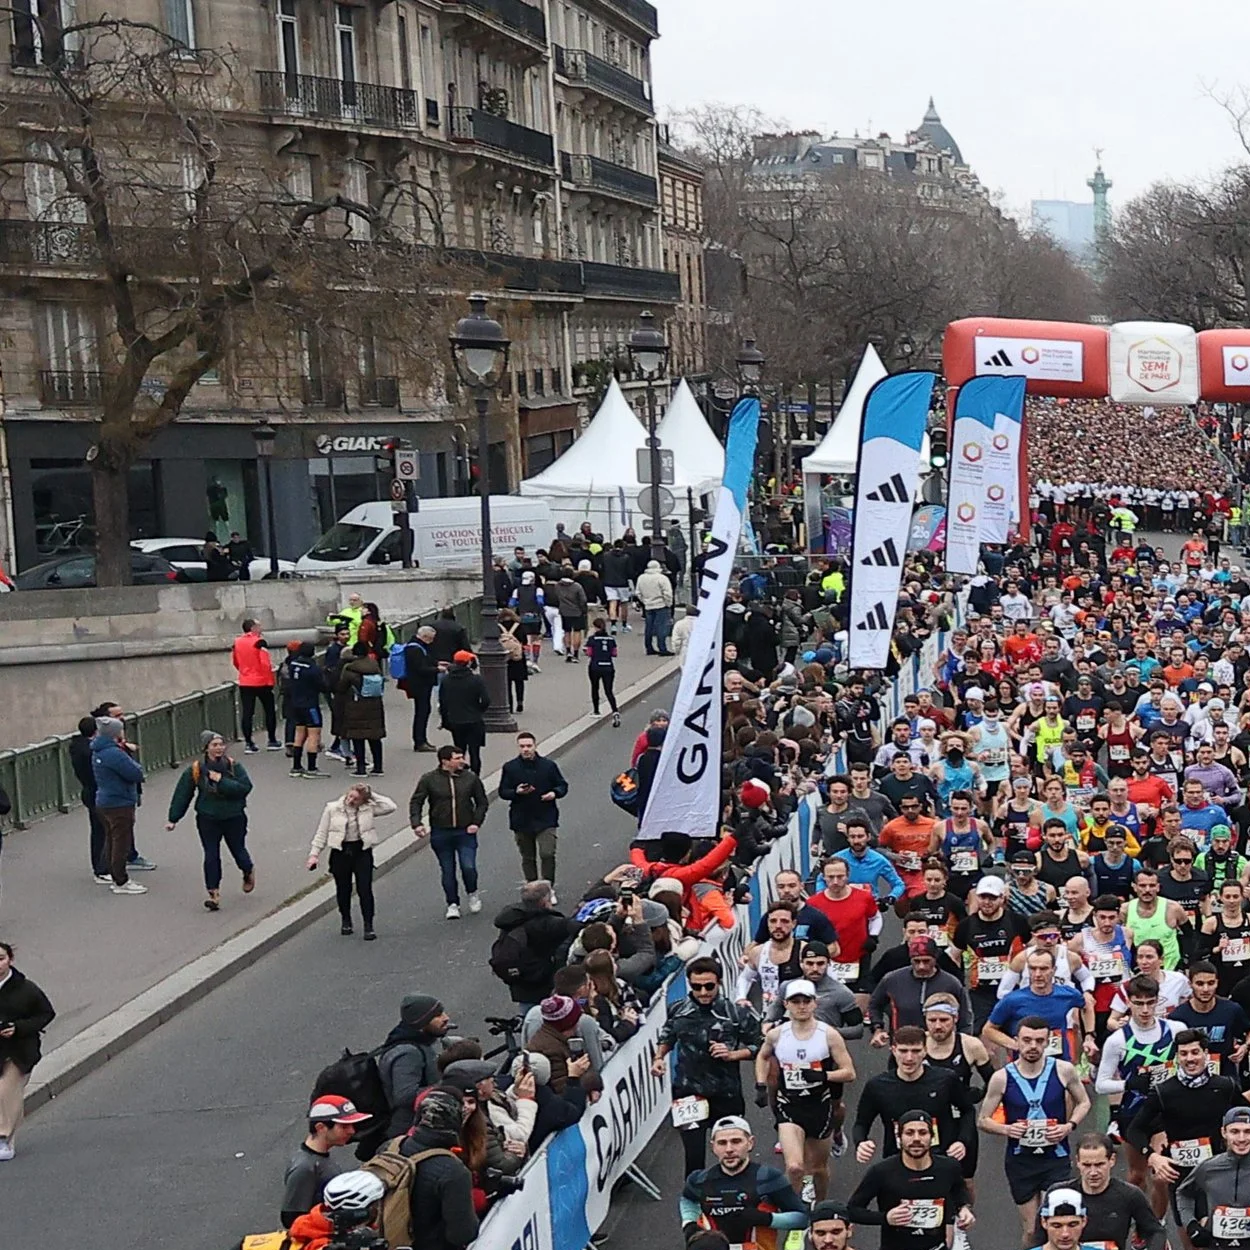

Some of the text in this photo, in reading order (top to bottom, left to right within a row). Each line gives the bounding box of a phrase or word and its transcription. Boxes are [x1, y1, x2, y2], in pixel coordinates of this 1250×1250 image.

[334, 437, 389, 450] GIAN
[431, 529, 475, 540] LOCATION
[492, 535, 517, 545] URÉES
[677, 538, 728, 784] GARIN
[978, 939, 1006, 949] ASPTT
[592, 1030, 664, 1192] GARMIN
[677, 1104, 699, 1117] 518
